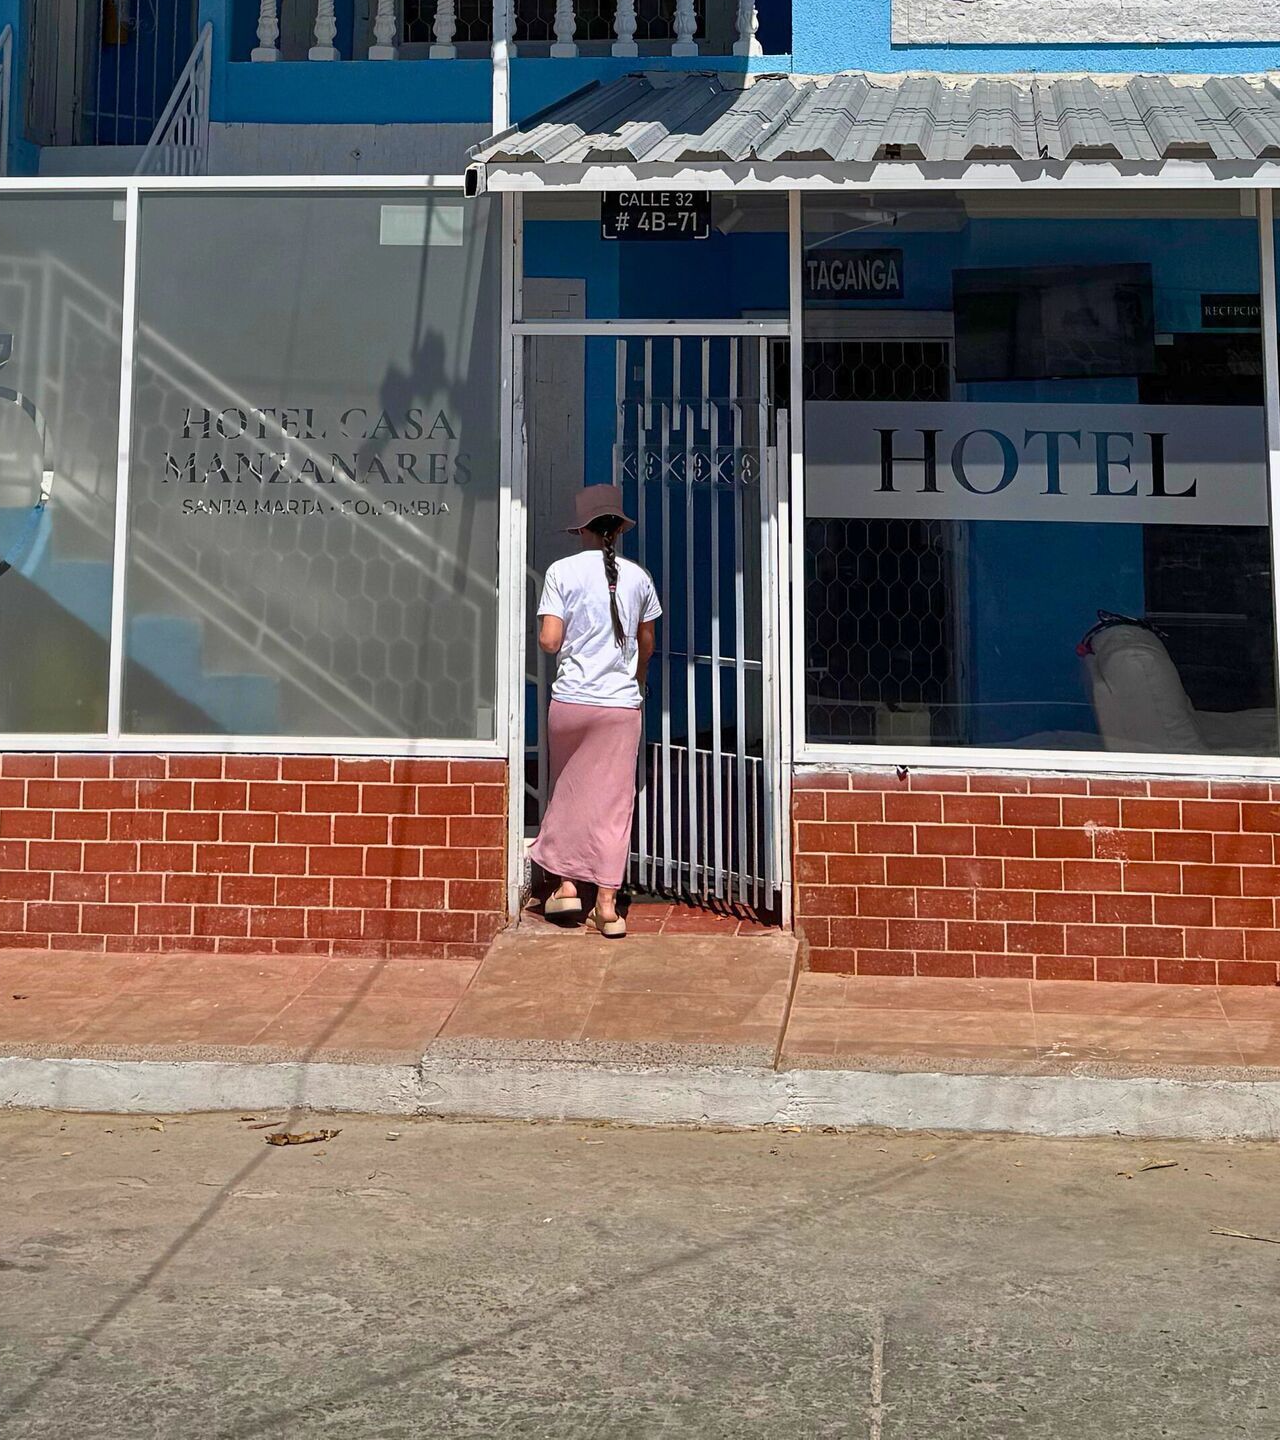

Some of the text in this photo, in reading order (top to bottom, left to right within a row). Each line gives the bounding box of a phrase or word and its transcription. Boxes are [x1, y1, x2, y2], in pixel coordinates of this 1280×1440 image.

[618, 192, 694, 207] CALLE 32
[615, 211, 697, 232] # 4B-71
[807, 259, 900, 291] TAGANGA
[1204, 304, 1262, 318] RECEPCIO
[181, 408, 458, 440] HOTEL CASA
[161, 451, 471, 485] MANZANARES
[872, 427, 1198, 498] HOTEL
[182, 499, 450, 517] SANTA MARTA COLOMBIA
